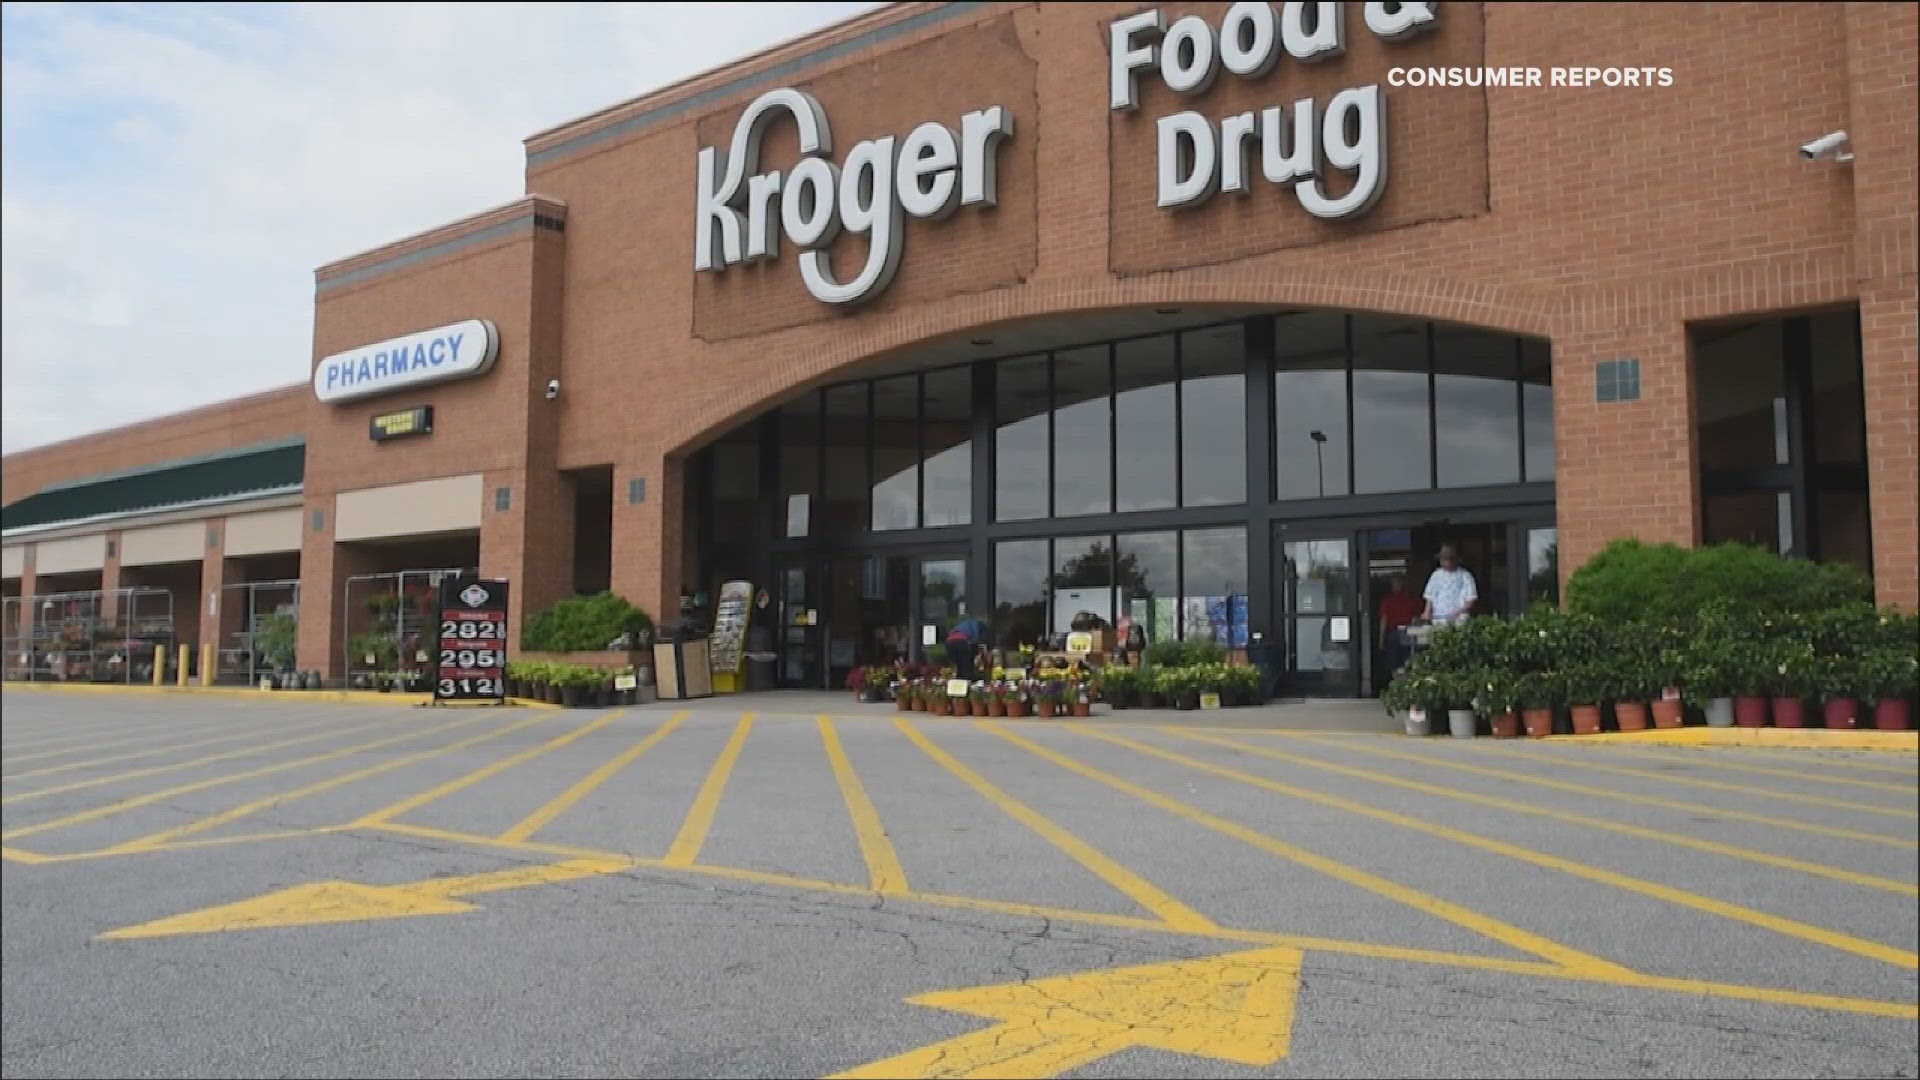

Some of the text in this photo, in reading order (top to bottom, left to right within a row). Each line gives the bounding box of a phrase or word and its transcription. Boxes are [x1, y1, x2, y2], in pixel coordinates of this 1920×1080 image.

[695, 87, 1011, 305] Kroger
[1156, 83, 1386, 218] Drug
[327, 333, 463, 389] PHARMACY
